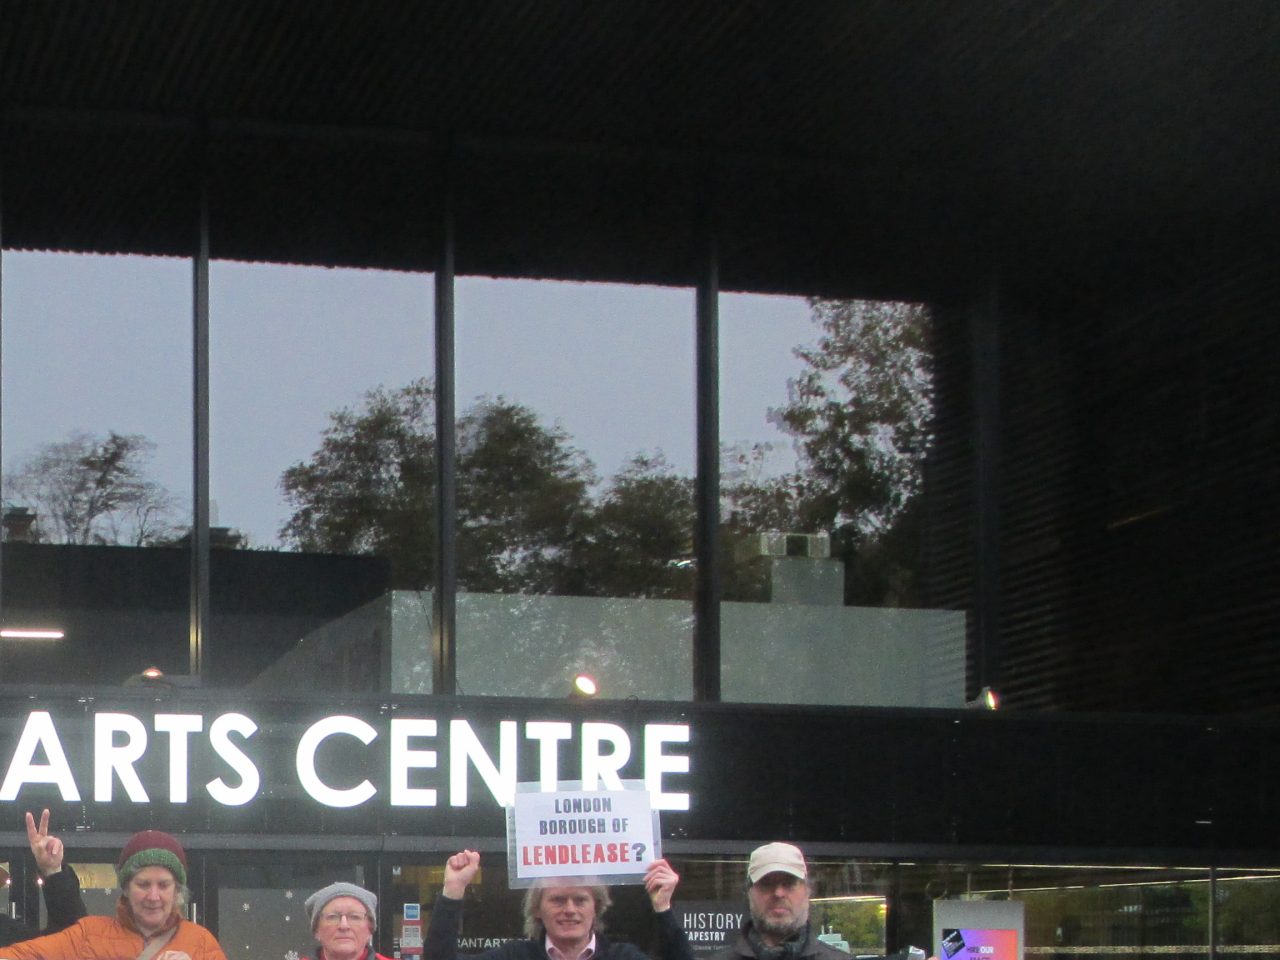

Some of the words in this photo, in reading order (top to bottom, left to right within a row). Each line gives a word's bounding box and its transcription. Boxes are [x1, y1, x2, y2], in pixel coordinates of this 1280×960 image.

[296, 716, 690, 810] CENTRE
[554, 797, 612, 814] LONDON
[539, 818, 606, 835] BOROUGH
[612, 818, 629, 833] OF
[522, 842, 647, 866] LENDLEASE?
[683, 912, 744, 930] HISTORY
[980, 946, 994, 954] OUR
